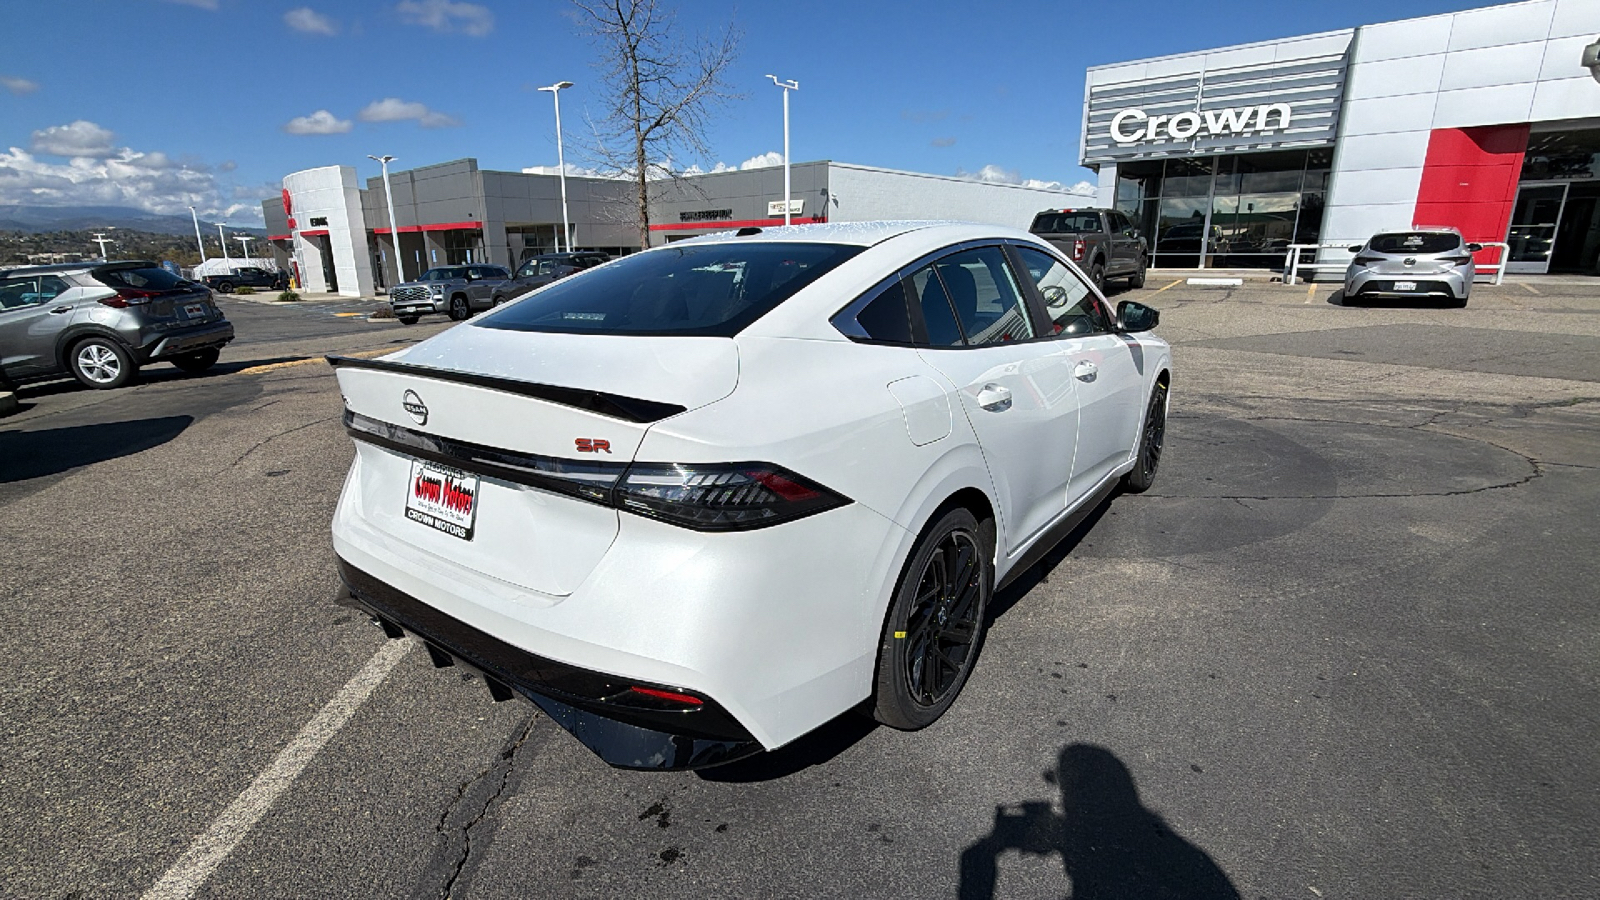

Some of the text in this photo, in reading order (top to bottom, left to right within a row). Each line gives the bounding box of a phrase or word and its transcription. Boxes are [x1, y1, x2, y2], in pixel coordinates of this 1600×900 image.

[1110, 102, 1292, 143] Crown
[403, 404, 427, 414] SSAN
[574, 438, 612, 454] SR
[415, 475, 441, 504] Crown
[441, 475, 474, 515] Motors
[408, 510, 434, 525] CROWN
[434, 519, 466, 537] MOTORS
